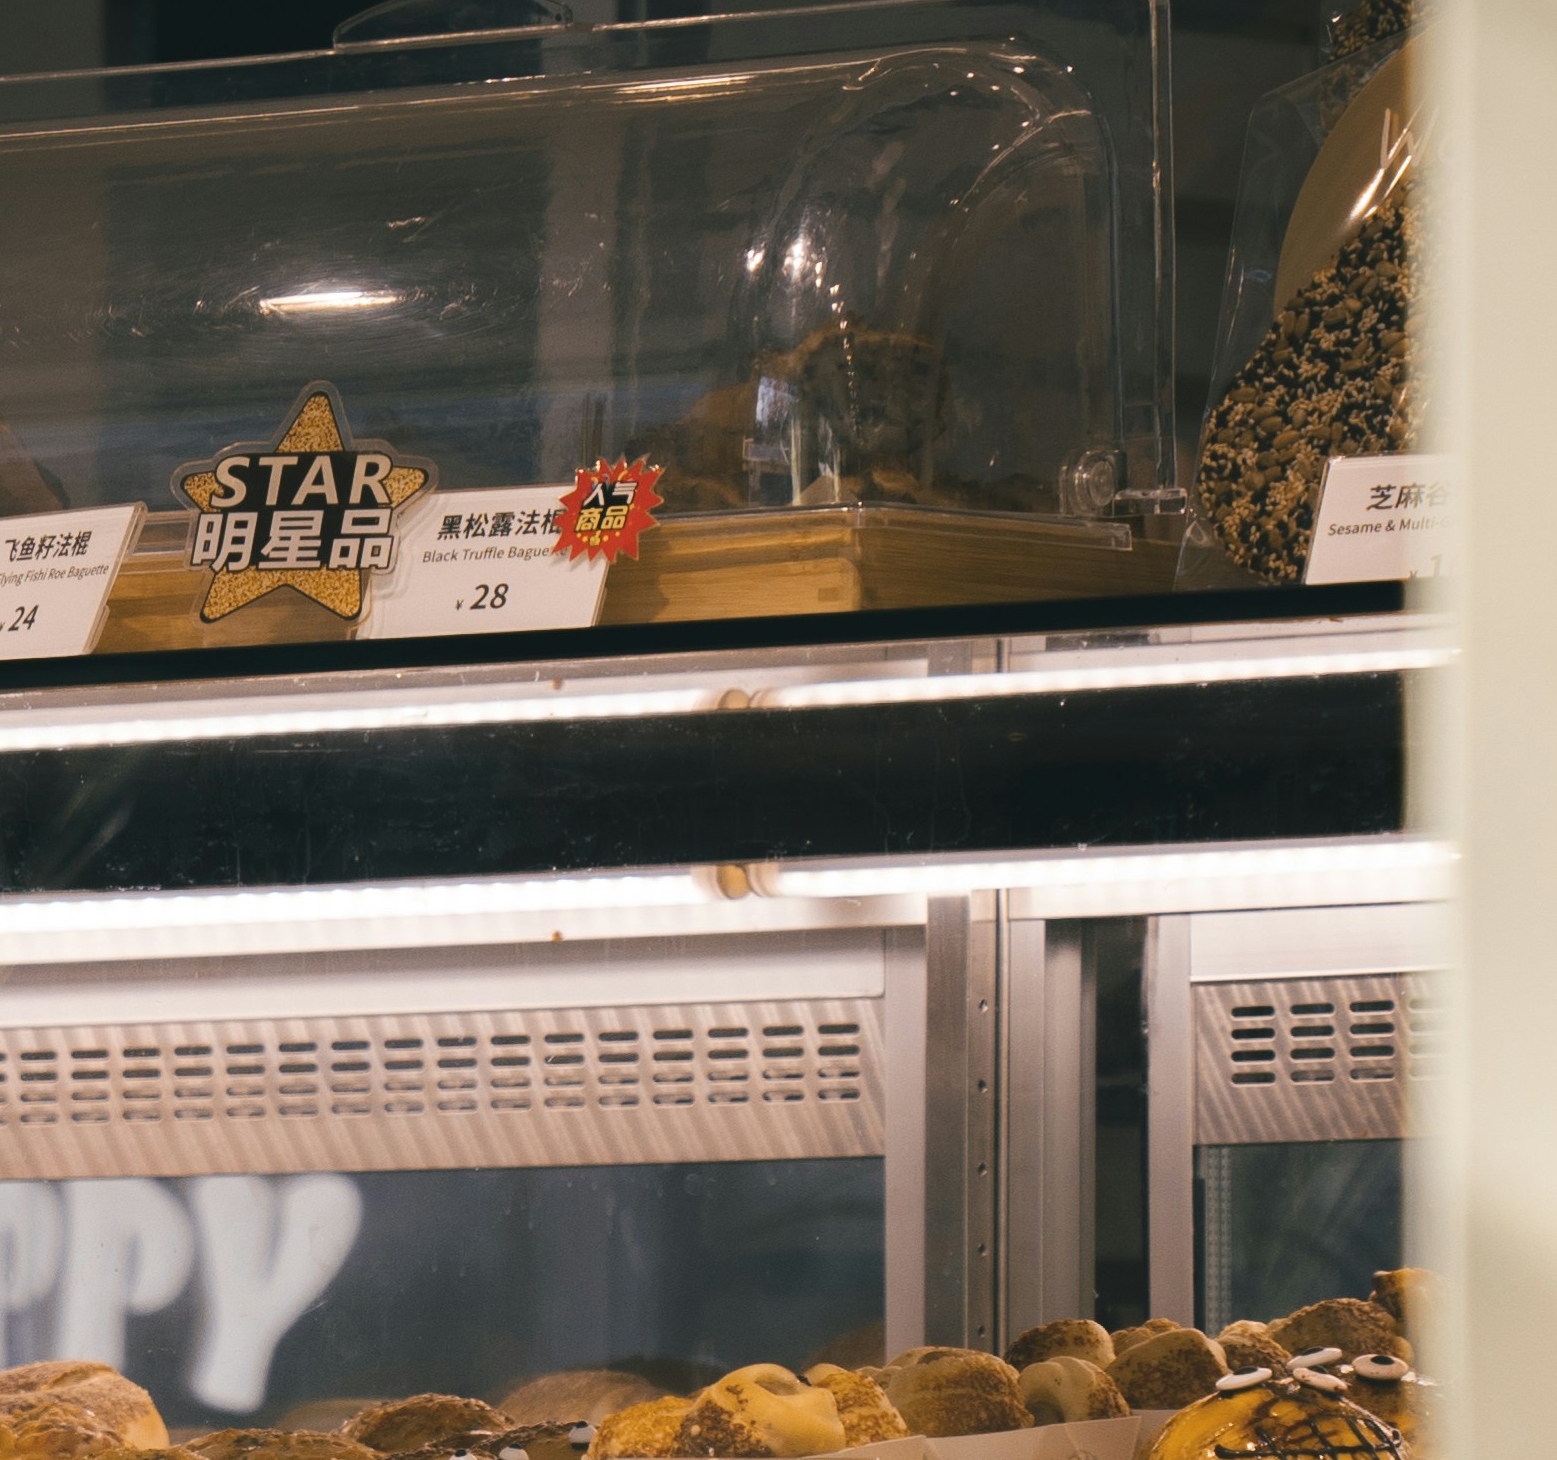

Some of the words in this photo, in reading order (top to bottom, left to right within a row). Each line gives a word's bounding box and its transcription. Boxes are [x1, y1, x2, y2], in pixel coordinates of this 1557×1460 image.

[211, 454, 393, 507] STAR
[583, 482, 637, 506] 人气
[576, 505, 630, 532] 商品
[1328, 524, 1381, 536] Sesame
[1385, 520, 1395, 531] &
[5, 531, 92, 561] 飞鱼籽法棍
[192, 509, 394, 571] 明星品
[422, 550, 457, 562] Black
[463, 548, 504, 561] Truffle
[49, 569, 65, 579] Roe
[67, 565, 109, 581] Baguette
